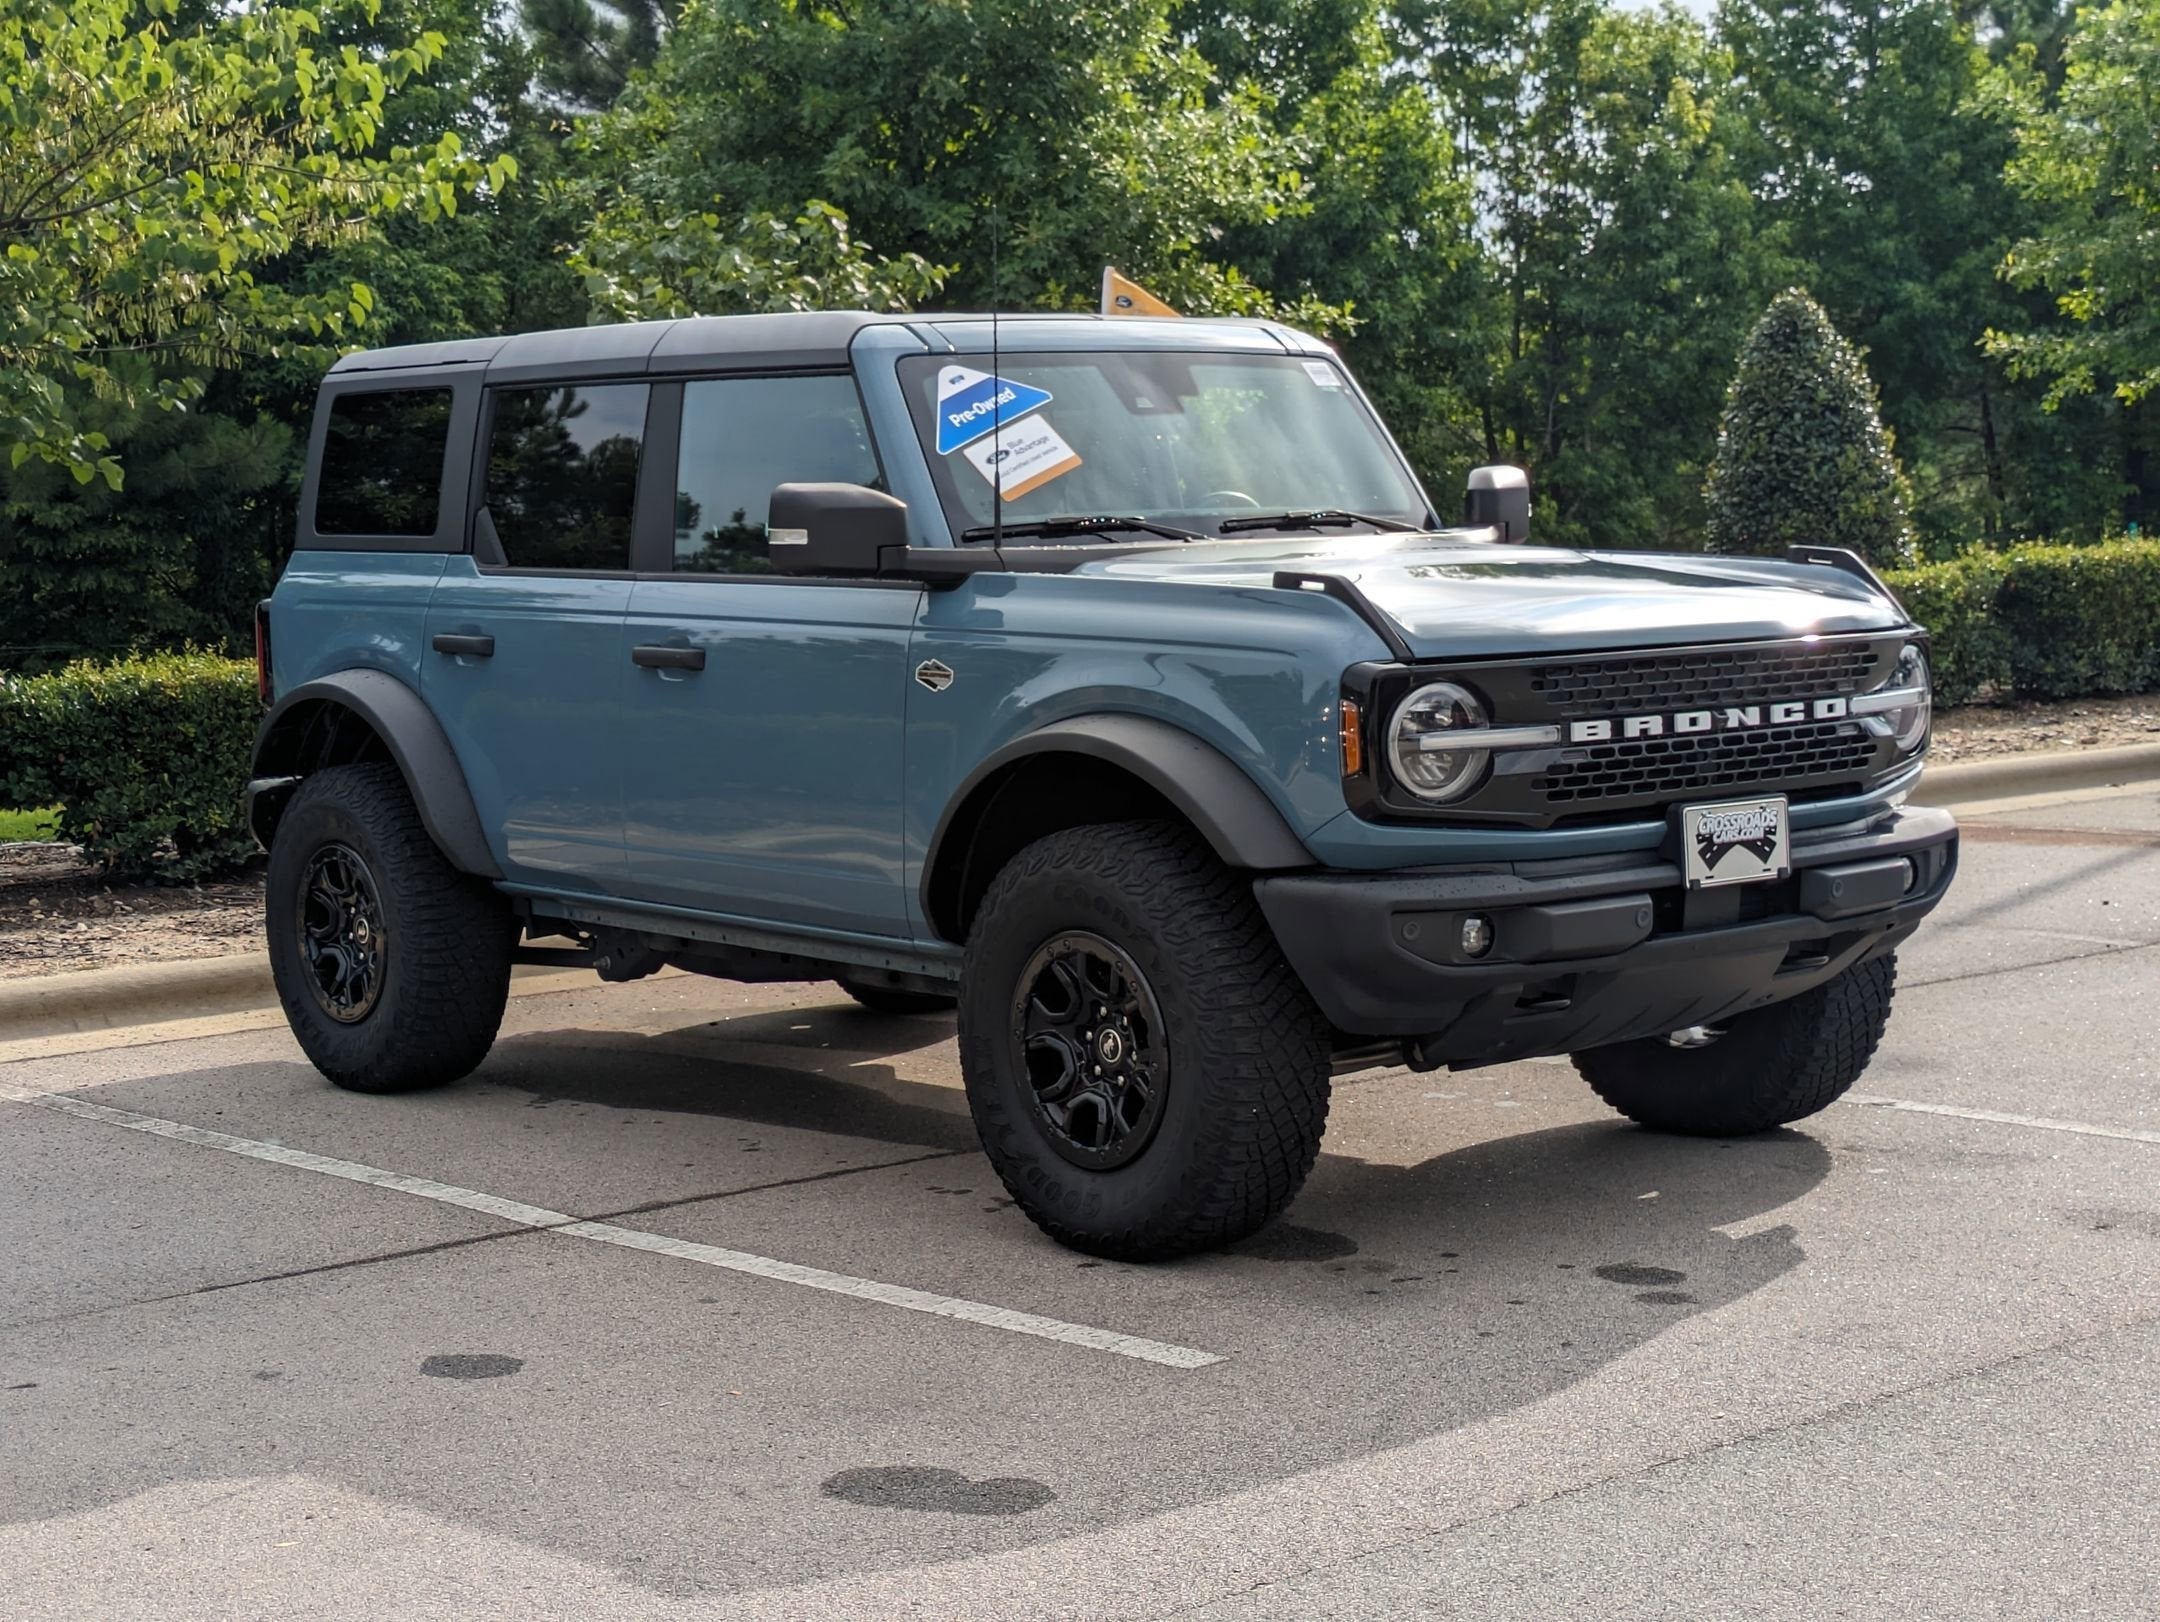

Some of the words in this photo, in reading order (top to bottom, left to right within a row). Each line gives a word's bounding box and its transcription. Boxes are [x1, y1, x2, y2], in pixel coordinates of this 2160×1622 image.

[1570, 698, 1847, 742] BRONCO
[1698, 810, 1777, 834] CROSSROADS
[1713, 827, 1764, 844] CARS.COM
